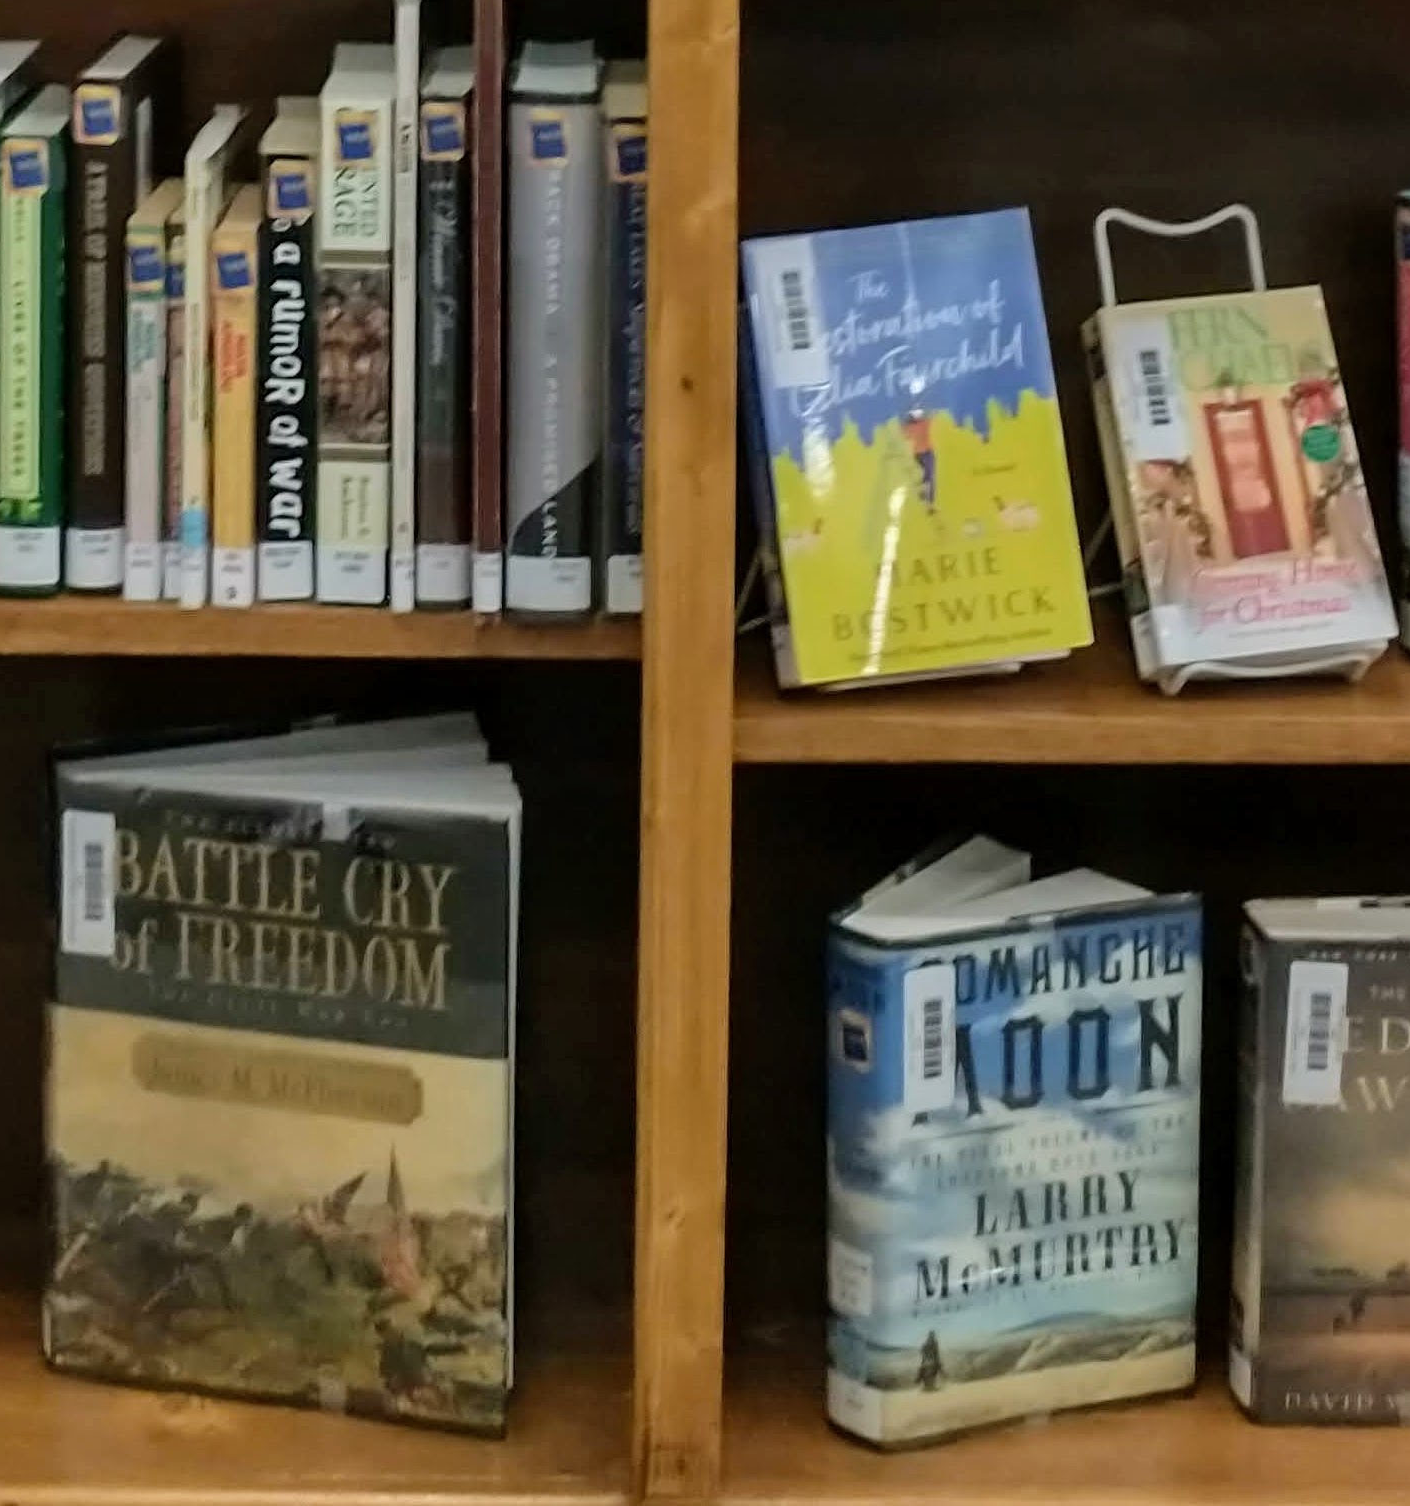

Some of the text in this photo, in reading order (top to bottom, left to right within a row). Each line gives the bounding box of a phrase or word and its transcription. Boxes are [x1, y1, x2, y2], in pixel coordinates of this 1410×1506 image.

[274, 242, 304, 266] a
[542, 237, 562, 316] OBAMA
[823, 278, 1006, 356] estoration of
[1166, 306, 1271, 351] FERN
[270, 415, 307, 447] of
[270, 457, 308, 538] war
[831, 587, 1059, 642] BOSTWICK
[115, 828, 460, 934] BATTLE CRY
[109, 913, 452, 1012] of FREEDOM
[919, 920, 1189, 1008] OMANCHE
[1369, 985, 1408, 1001] THE
[973, 1170, 1143, 1238] LARRY
[913, 1216, 1189, 1303] McMURTRY
[1283, 1392, 1383, 1412] DAVID
